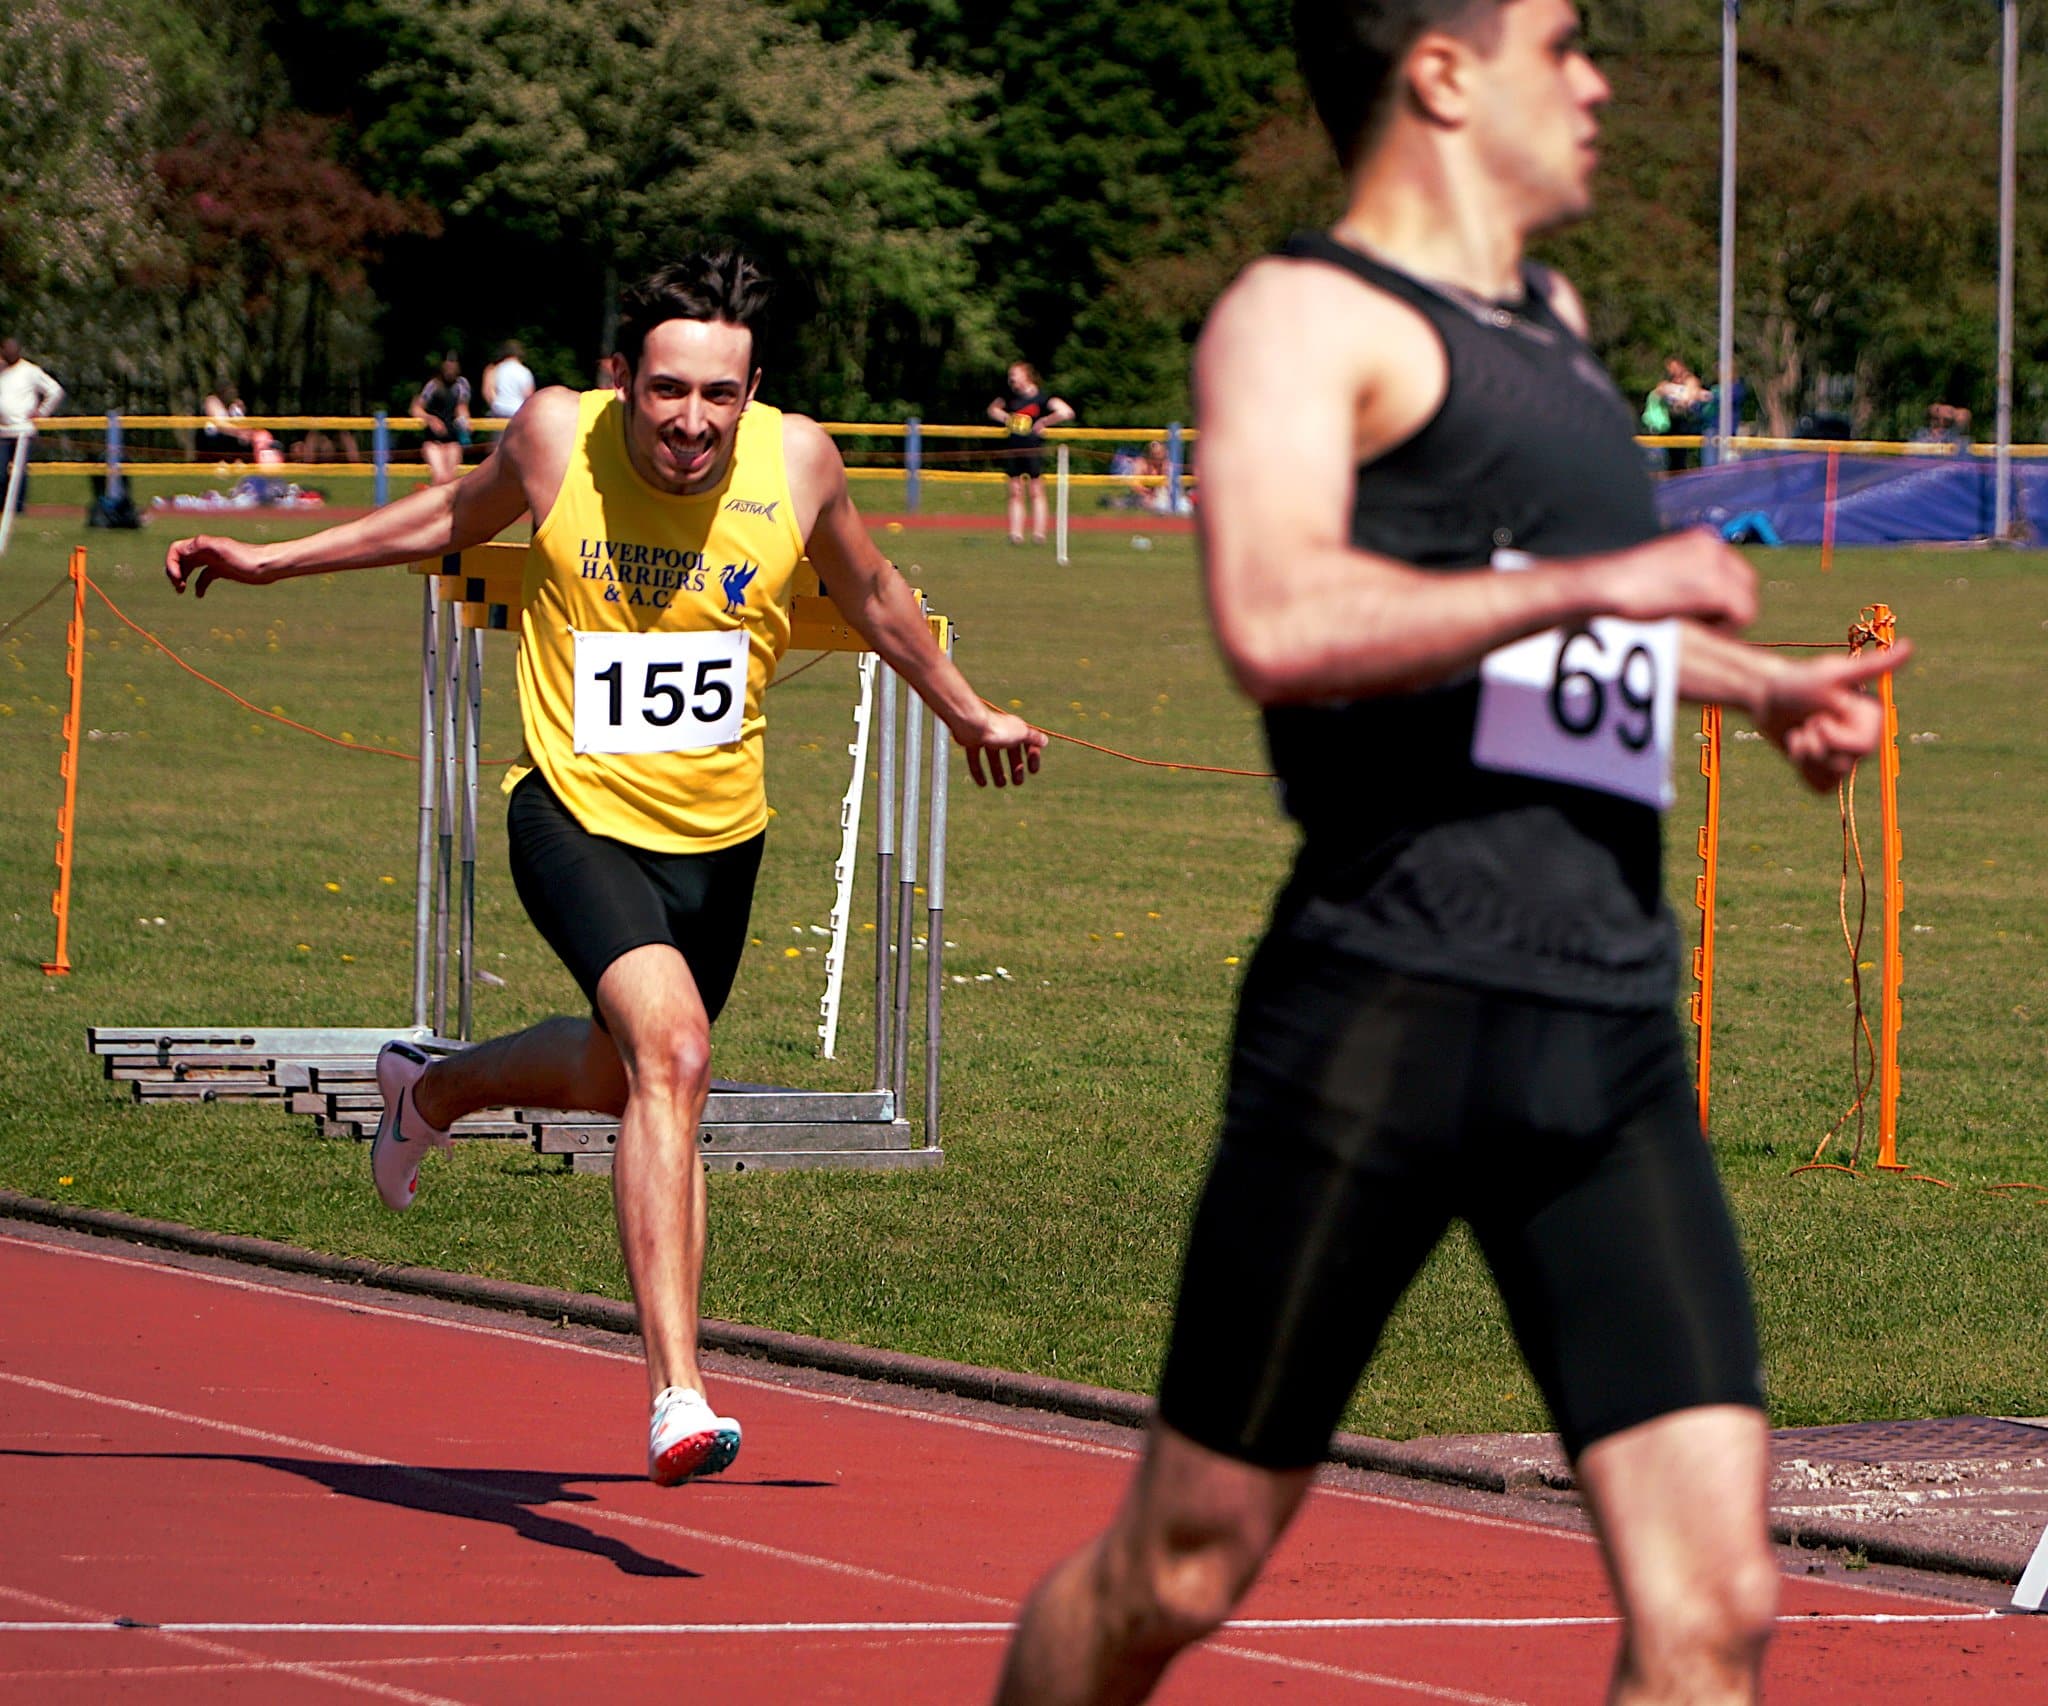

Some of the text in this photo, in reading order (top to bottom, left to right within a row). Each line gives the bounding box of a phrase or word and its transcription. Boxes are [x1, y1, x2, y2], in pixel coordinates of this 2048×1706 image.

[579, 538, 711, 572] LIVERPOOL
[581, 559, 706, 592] HARRIERS
[603, 583, 621, 602] &
[594, 658, 733, 727] 155
[1551, 629, 1656, 754] 69
